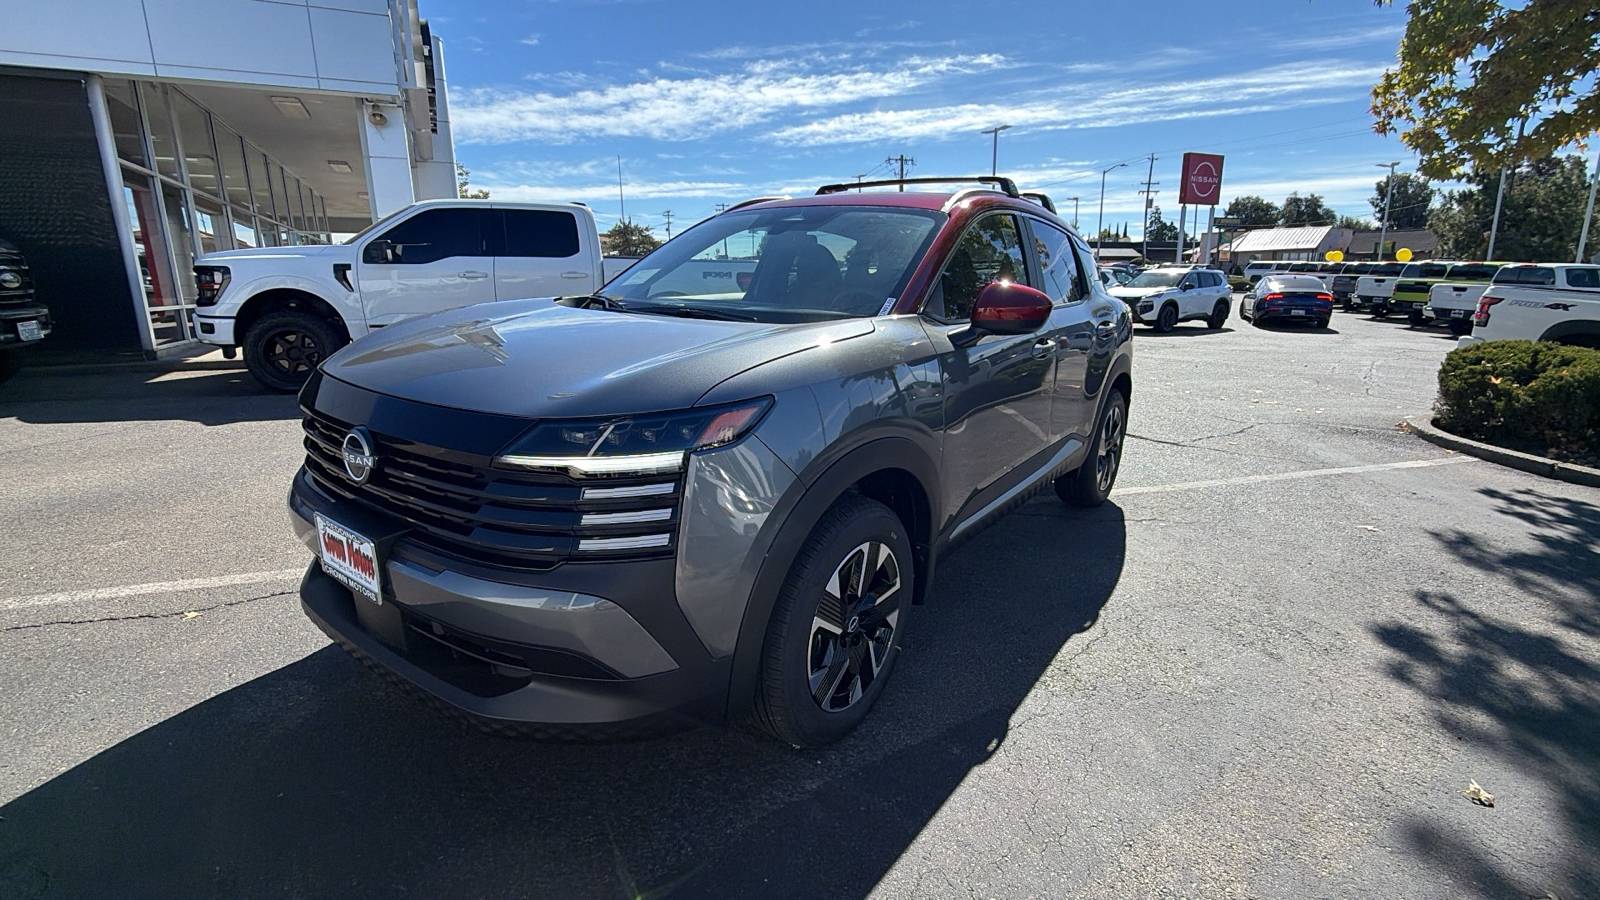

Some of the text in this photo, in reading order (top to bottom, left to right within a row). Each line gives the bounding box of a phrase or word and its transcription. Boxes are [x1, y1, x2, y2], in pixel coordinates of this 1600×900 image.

[1191, 175, 1218, 183] NISSAN
[344, 452, 372, 466] SSAN
[324, 565, 348, 585] CROWN
[348, 579, 377, 601] MOTORS
